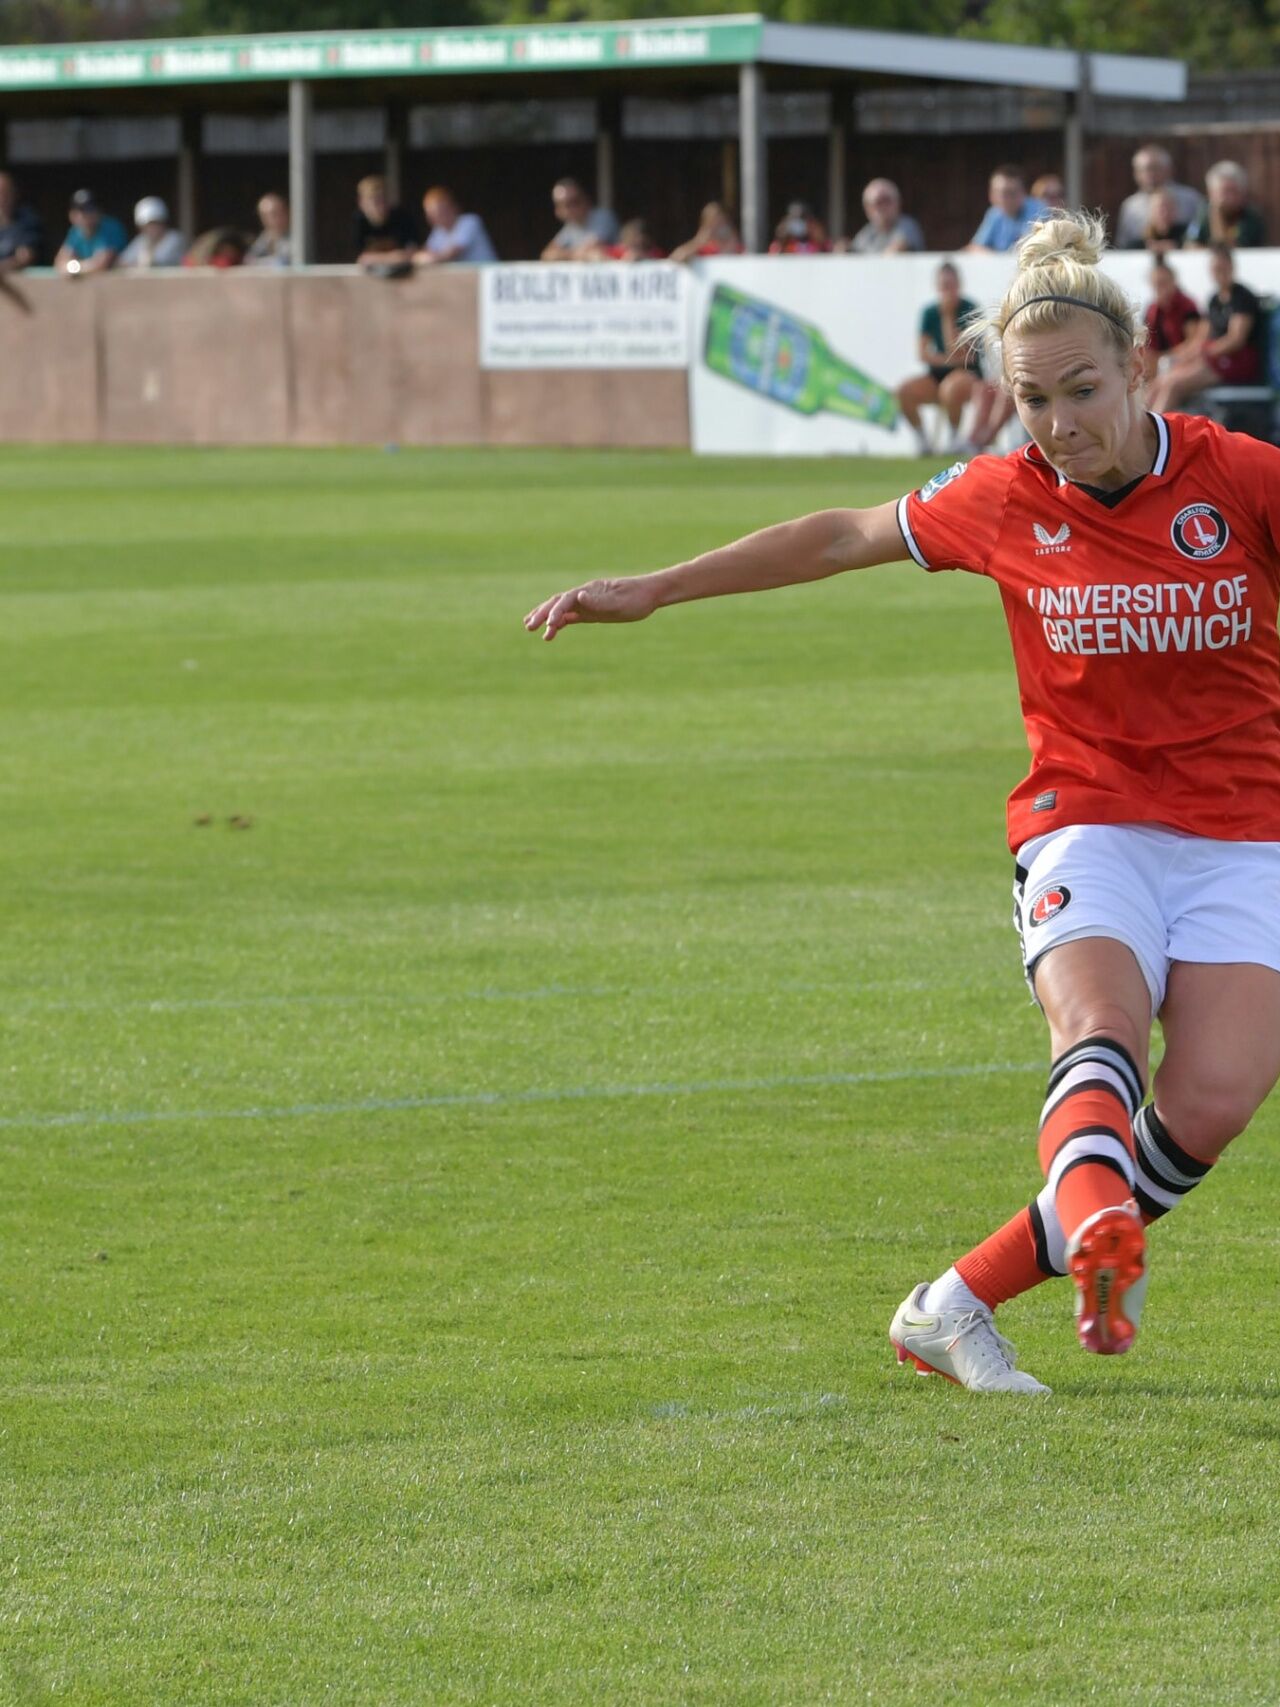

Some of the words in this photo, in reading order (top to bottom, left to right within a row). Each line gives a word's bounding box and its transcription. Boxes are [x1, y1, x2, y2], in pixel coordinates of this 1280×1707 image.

[629, 270, 679, 301] HIRE
[1176, 507, 1211, 526] CHARLTON
[1192, 541, 1221, 557] ATHLETIC
[1026, 582, 1205, 616] UNIVERSITY
[1213, 574, 1248, 610] OF
[1042, 607, 1252, 655] GREENWICH
